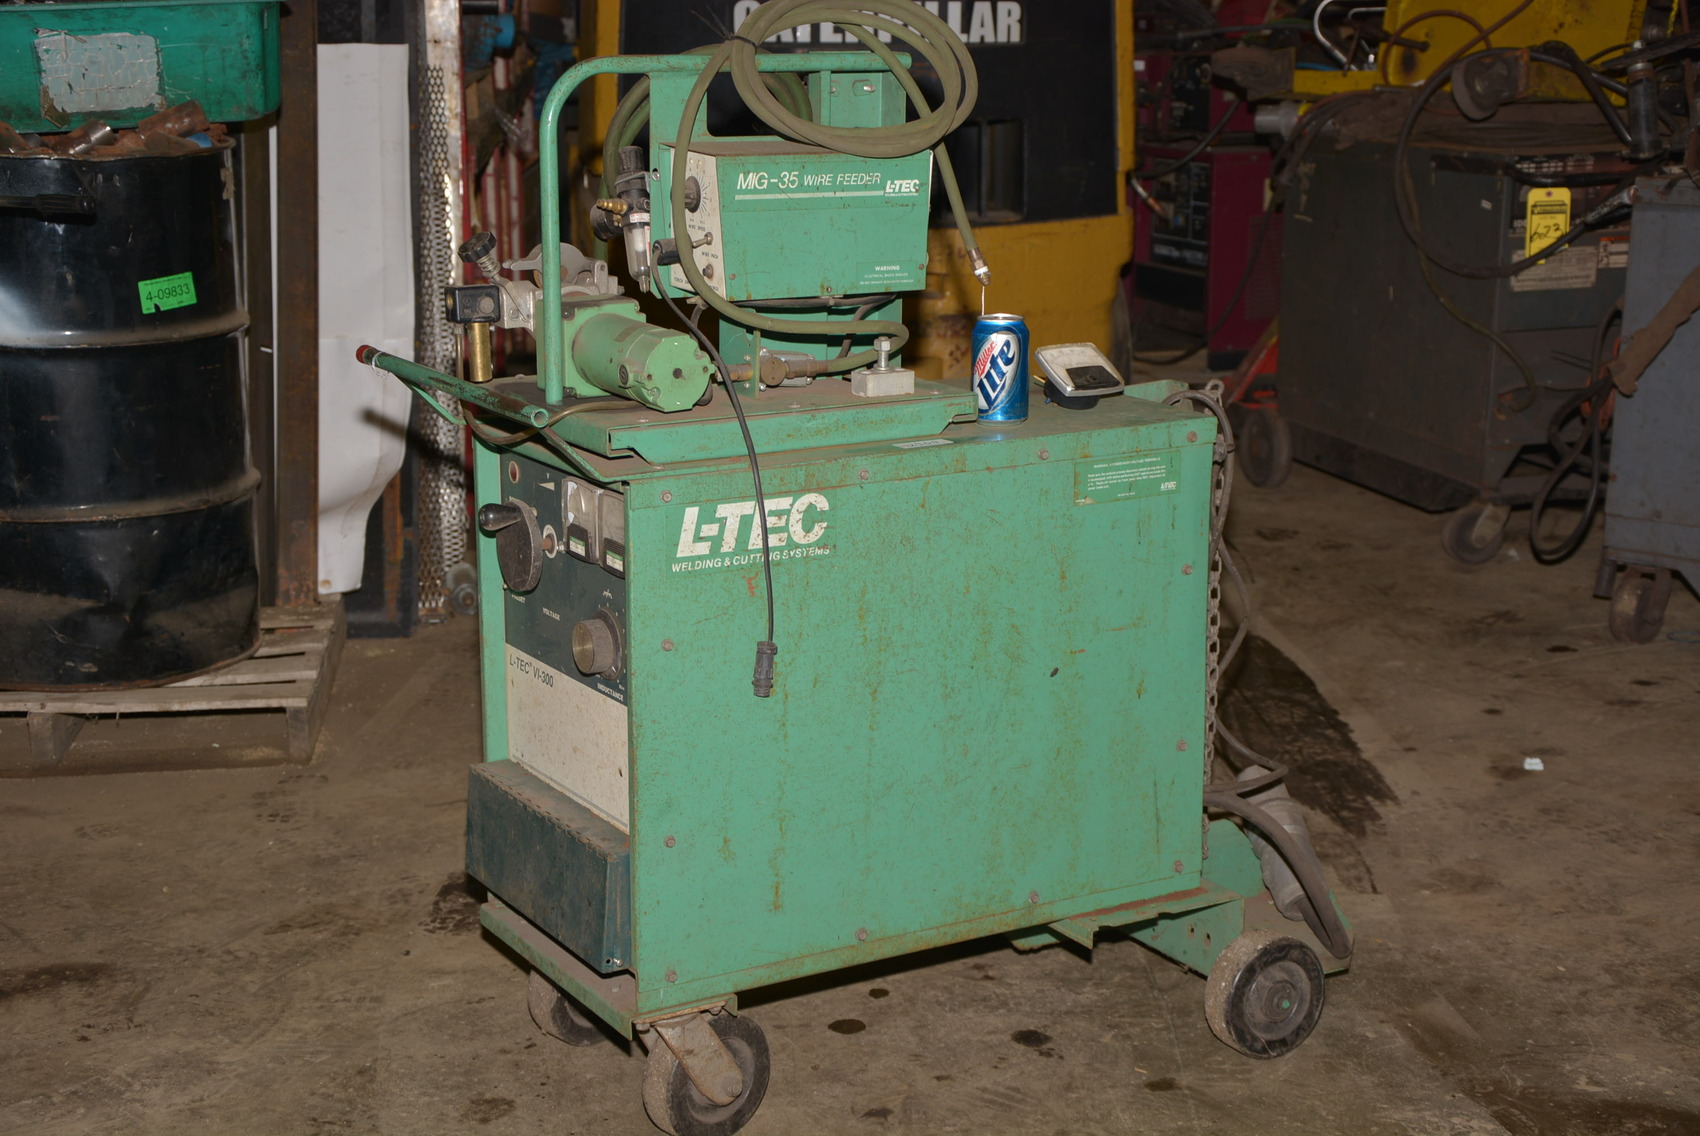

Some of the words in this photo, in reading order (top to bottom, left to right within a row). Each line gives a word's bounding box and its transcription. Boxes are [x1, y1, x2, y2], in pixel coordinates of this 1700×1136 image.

[733, 0, 1022, 44] CATELAR
[737, 171, 799, 190] MIG-35
[803, 173, 833, 186] WIRE
[836, 172, 881, 186] FEEDER
[884, 179, 920, 193] L-TEC
[146, 282, 190, 302] 4-09833
[676, 493, 830, 558] L-TEC
[671, 558, 722, 573] WELDING
[724, 557, 731, 567] &
[733, 549, 780, 565] CUTTIG
[782, 545, 830, 560] SYSTEMS
[542, 607, 561, 621] VOLTAGE
[532, 664, 554, 688] VI-300
[597, 682, 624, 702] INDUCTANCE
